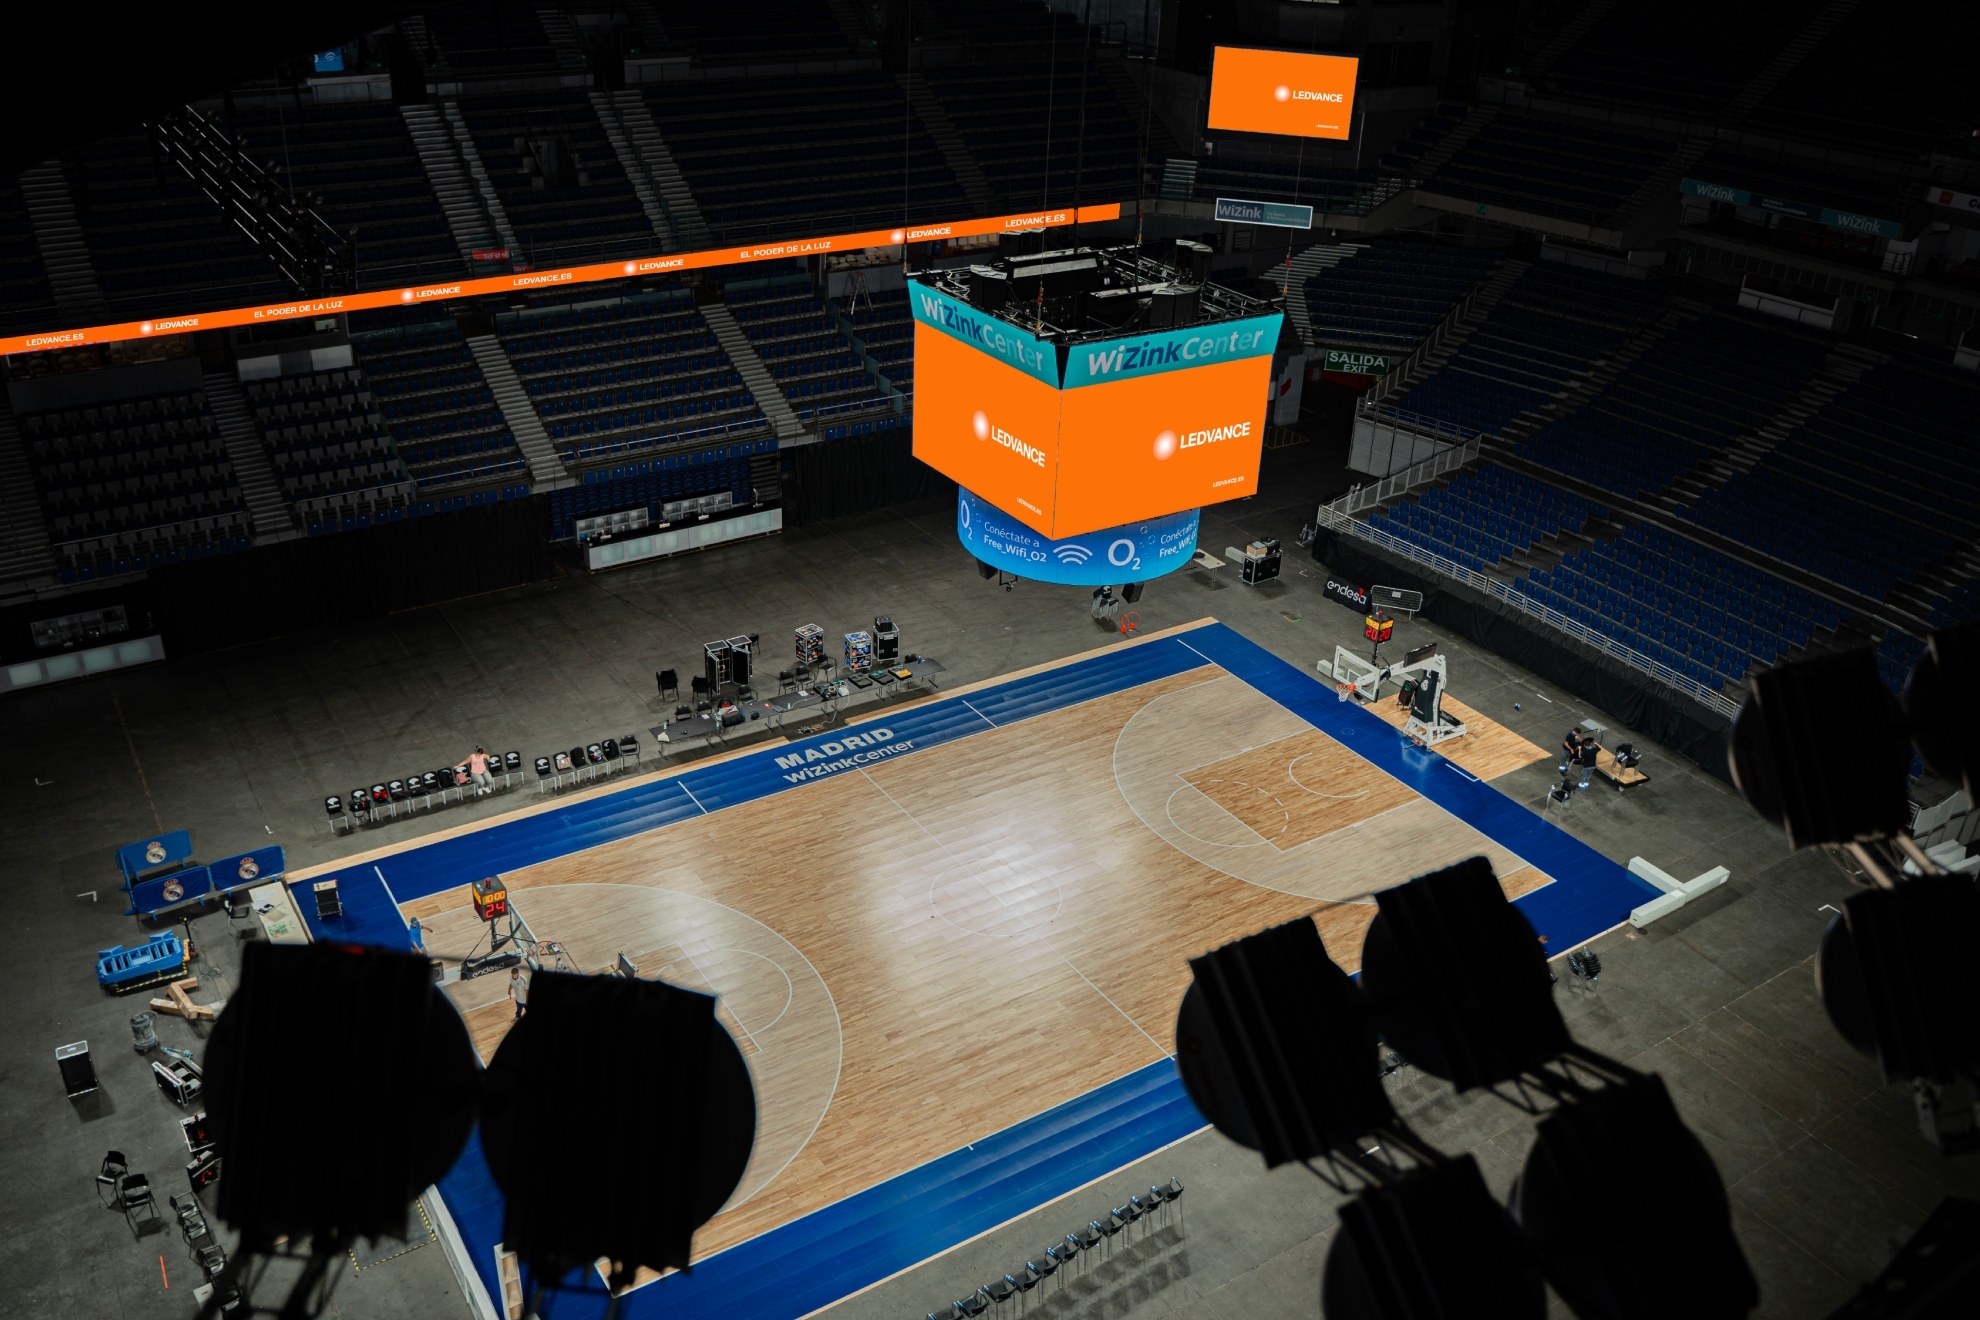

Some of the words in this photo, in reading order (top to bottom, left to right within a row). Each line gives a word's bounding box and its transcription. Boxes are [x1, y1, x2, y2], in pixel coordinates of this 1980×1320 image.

[1293, 90, 1343, 103] LEDVANCE
[1697, 184, 1735, 201] WiZink
[1218, 204, 1262, 220] WiZink
[1005, 213, 1066, 228] LEDVANCE.ES
[1837, 214, 1882, 233] WiZink
[906, 226, 952, 240] LEDVANCE
[741, 251, 751, 259] EL
[753, 246, 784, 257] PODER
[786, 245, 799, 253] DE
[801, 244, 812, 252] LA
[814, 241, 831, 250] LUZ
[639, 258, 684, 271] LEDVANCE
[513, 272, 572, 287] LEDVANCE.ES
[416, 286, 461, 298] LEDVANCE
[254, 311, 265, 319] EL
[267, 307, 297, 317] PODER
[299, 304, 311, 313] DE
[313, 303, 324, 311] LA
[326, 301, 343, 310] LUZ
[155, 318, 199, 331] LEDVANCE
[920, 293, 1043, 371] WiZinkCenter
[26, 332, 84, 347] LEDVANCE.ES
[1088, 329, 1264, 376] WiZinkCenter
[1329, 352, 1385, 368] SALIDA
[1343, 363, 1369, 373] EXIT
[1180, 421, 1251, 449] LEDVANCE
[991, 425, 1046, 468] LEDVANCE
[1213, 475, 1245, 488] LEDVANCE.ES
[984, 521, 1031, 546] Conéctate
[1033, 539, 1040, 548] a
[1326, 580, 1367, 605] endesa
[774, 728, 895, 770] MADRID
[485, 890, 506, 903] 10:00
[485, 901, 505, 919] 24
[472, 962, 505, 978] endesa
